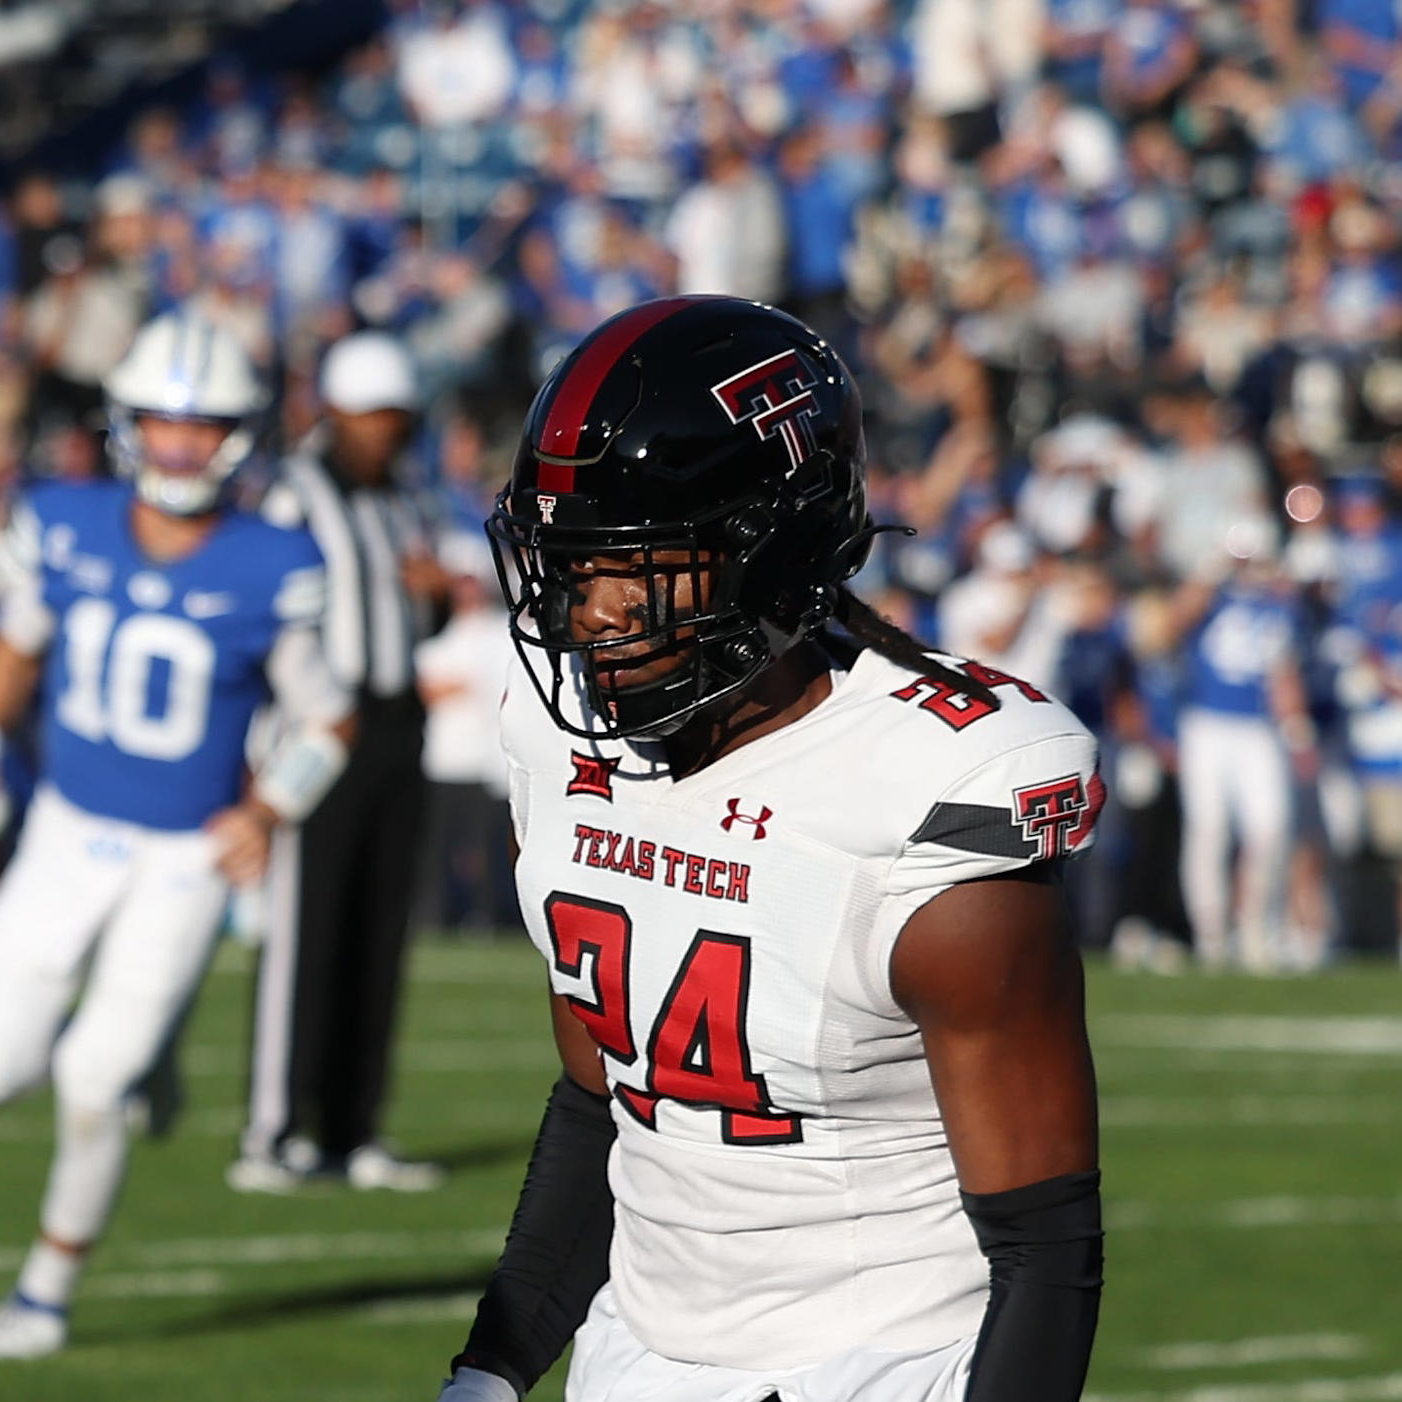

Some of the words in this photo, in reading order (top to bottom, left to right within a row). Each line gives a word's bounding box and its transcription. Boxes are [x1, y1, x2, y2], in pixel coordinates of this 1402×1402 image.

[54, 598, 217, 764] 10
[572, 823, 657, 882] TEXAS
[660, 846, 751, 904] TECH
[543, 889, 804, 1146] 24
